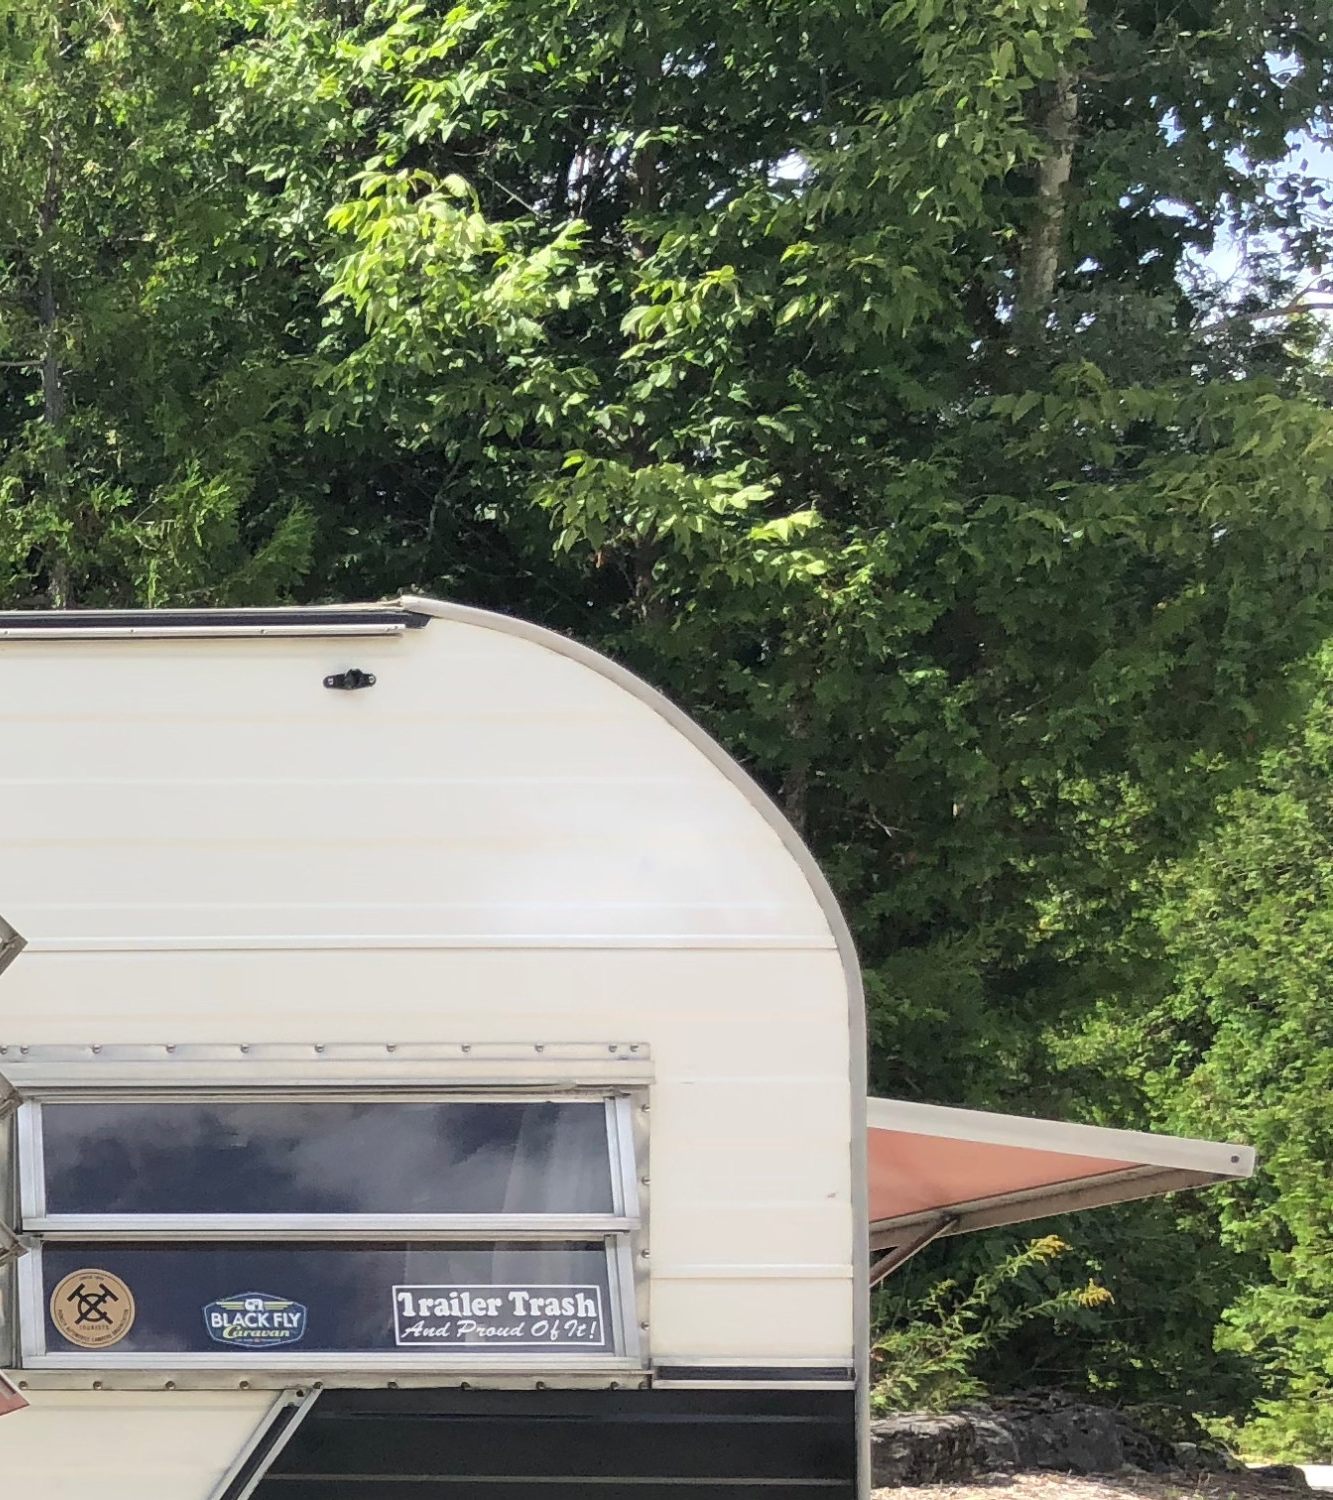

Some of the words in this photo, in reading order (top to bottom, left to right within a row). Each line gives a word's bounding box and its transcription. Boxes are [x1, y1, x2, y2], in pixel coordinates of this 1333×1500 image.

[397, 1291, 502, 1318] Trailer
[508, 1290, 597, 1318] Trash
[210, 1312, 269, 1328] BLACK
[273, 1312, 301, 1329] FLY
[400, 1320, 451, 1338] And
[456, 1319, 525, 1338] Proud
[530, 1320, 560, 1341] Of
[564, 1320, 597, 1339] It!
[222, 1322, 291, 1340] Caravan
